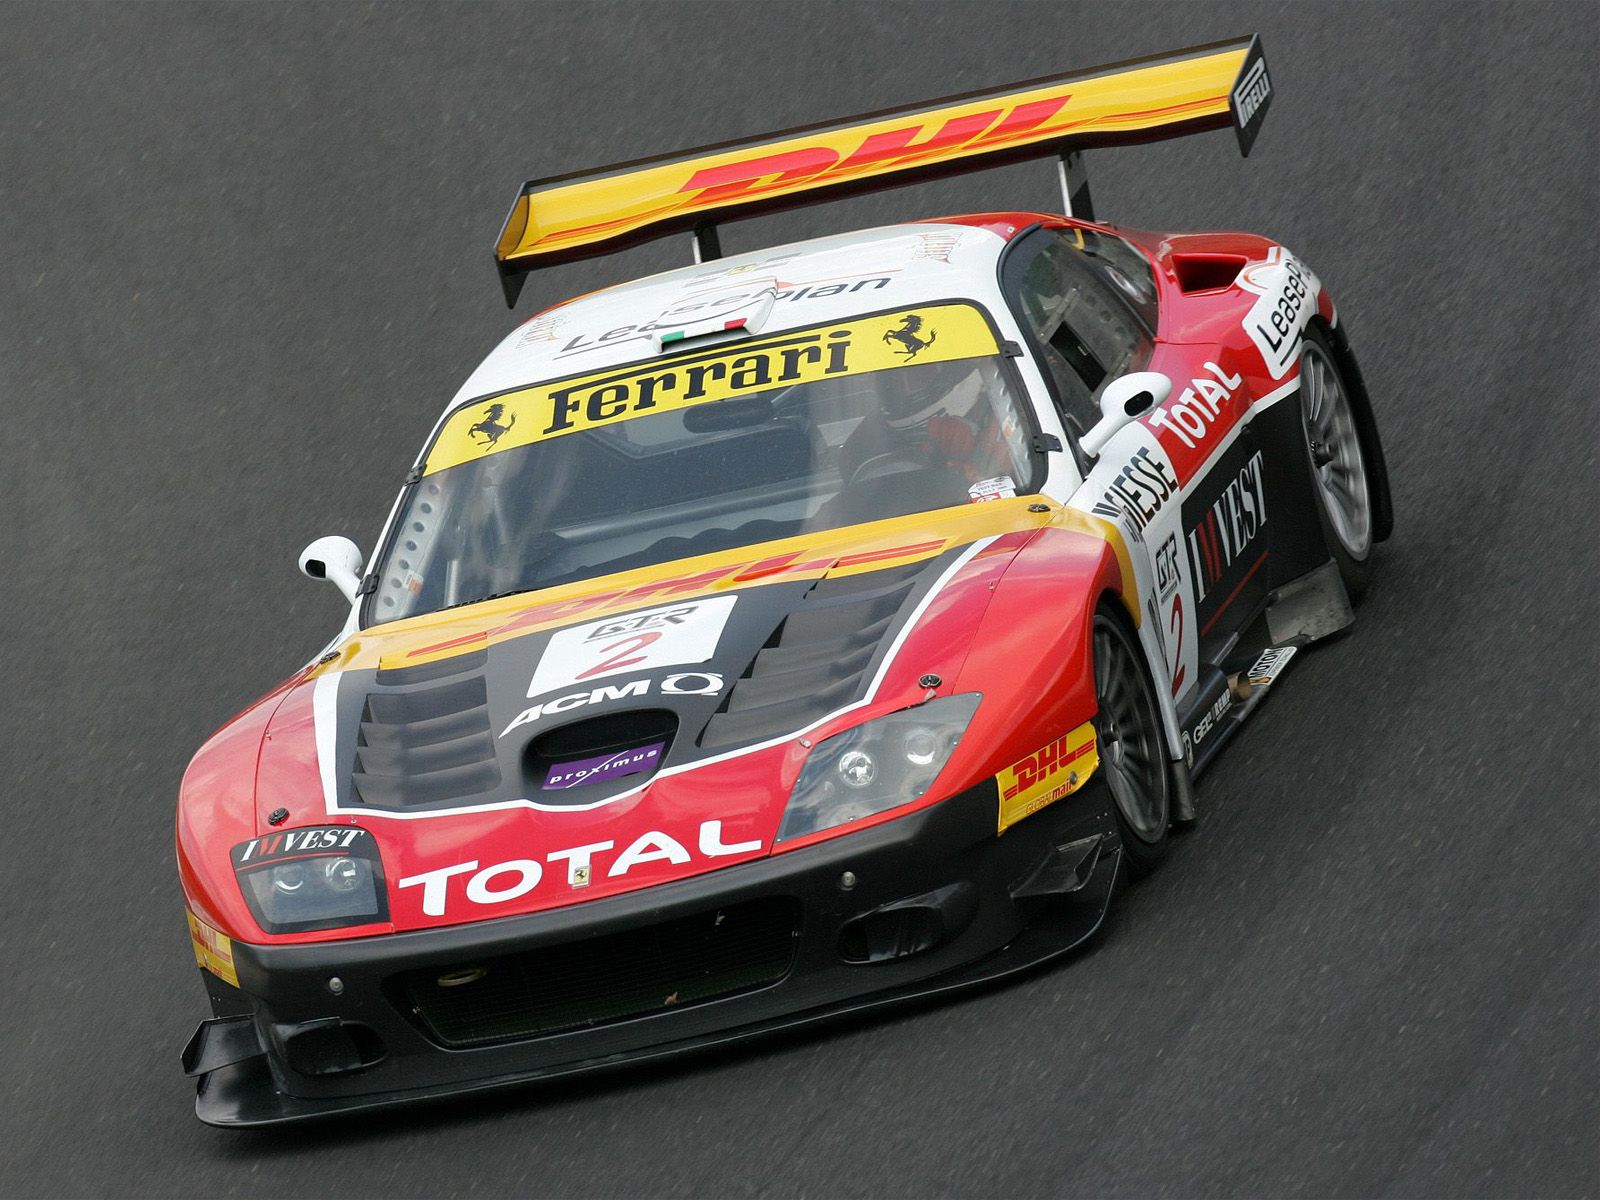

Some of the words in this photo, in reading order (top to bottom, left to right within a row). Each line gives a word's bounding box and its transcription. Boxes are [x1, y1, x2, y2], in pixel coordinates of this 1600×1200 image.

[1233, 57, 1271, 128] PIRELLI
[678, 95, 1072, 202] DHL
[542, 330, 852, 435] Ferrari
[1149, 361, 1243, 448] TOTAL
[575, 632, 662, 680] 2
[1171, 593, 1186, 699] 2
[550, 750, 657, 788] proximus
[1013, 736, 1076, 793] DHL
[400, 820, 762, 916] TOTAL
